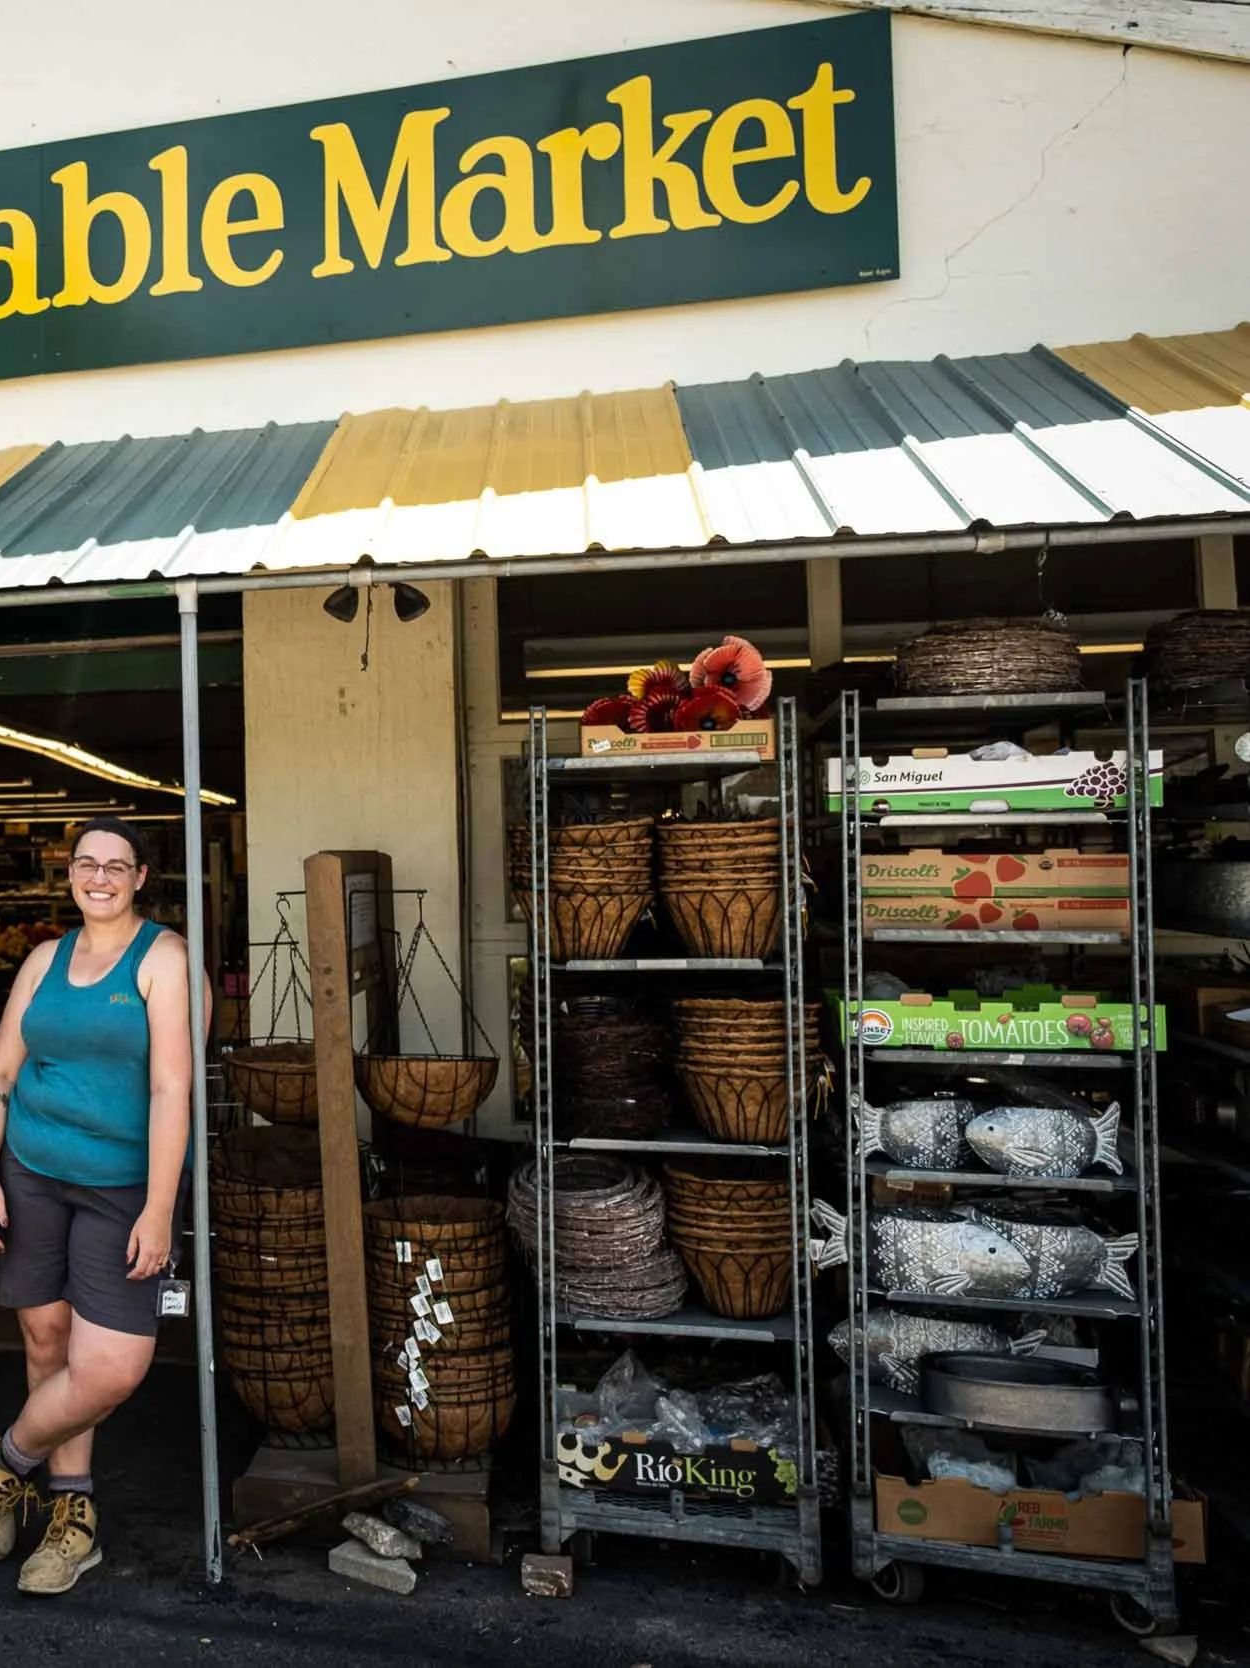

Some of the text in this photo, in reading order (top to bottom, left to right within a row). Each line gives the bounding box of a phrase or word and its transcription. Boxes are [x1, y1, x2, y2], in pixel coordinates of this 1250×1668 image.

[310, 62, 872, 278] Market
[873, 770, 943, 784] San Miguel
[866, 863, 940, 878] Driscoll's
[866, 903, 940, 919] Driscoll's
[957, 1019, 1069, 1045] TOMATOES
